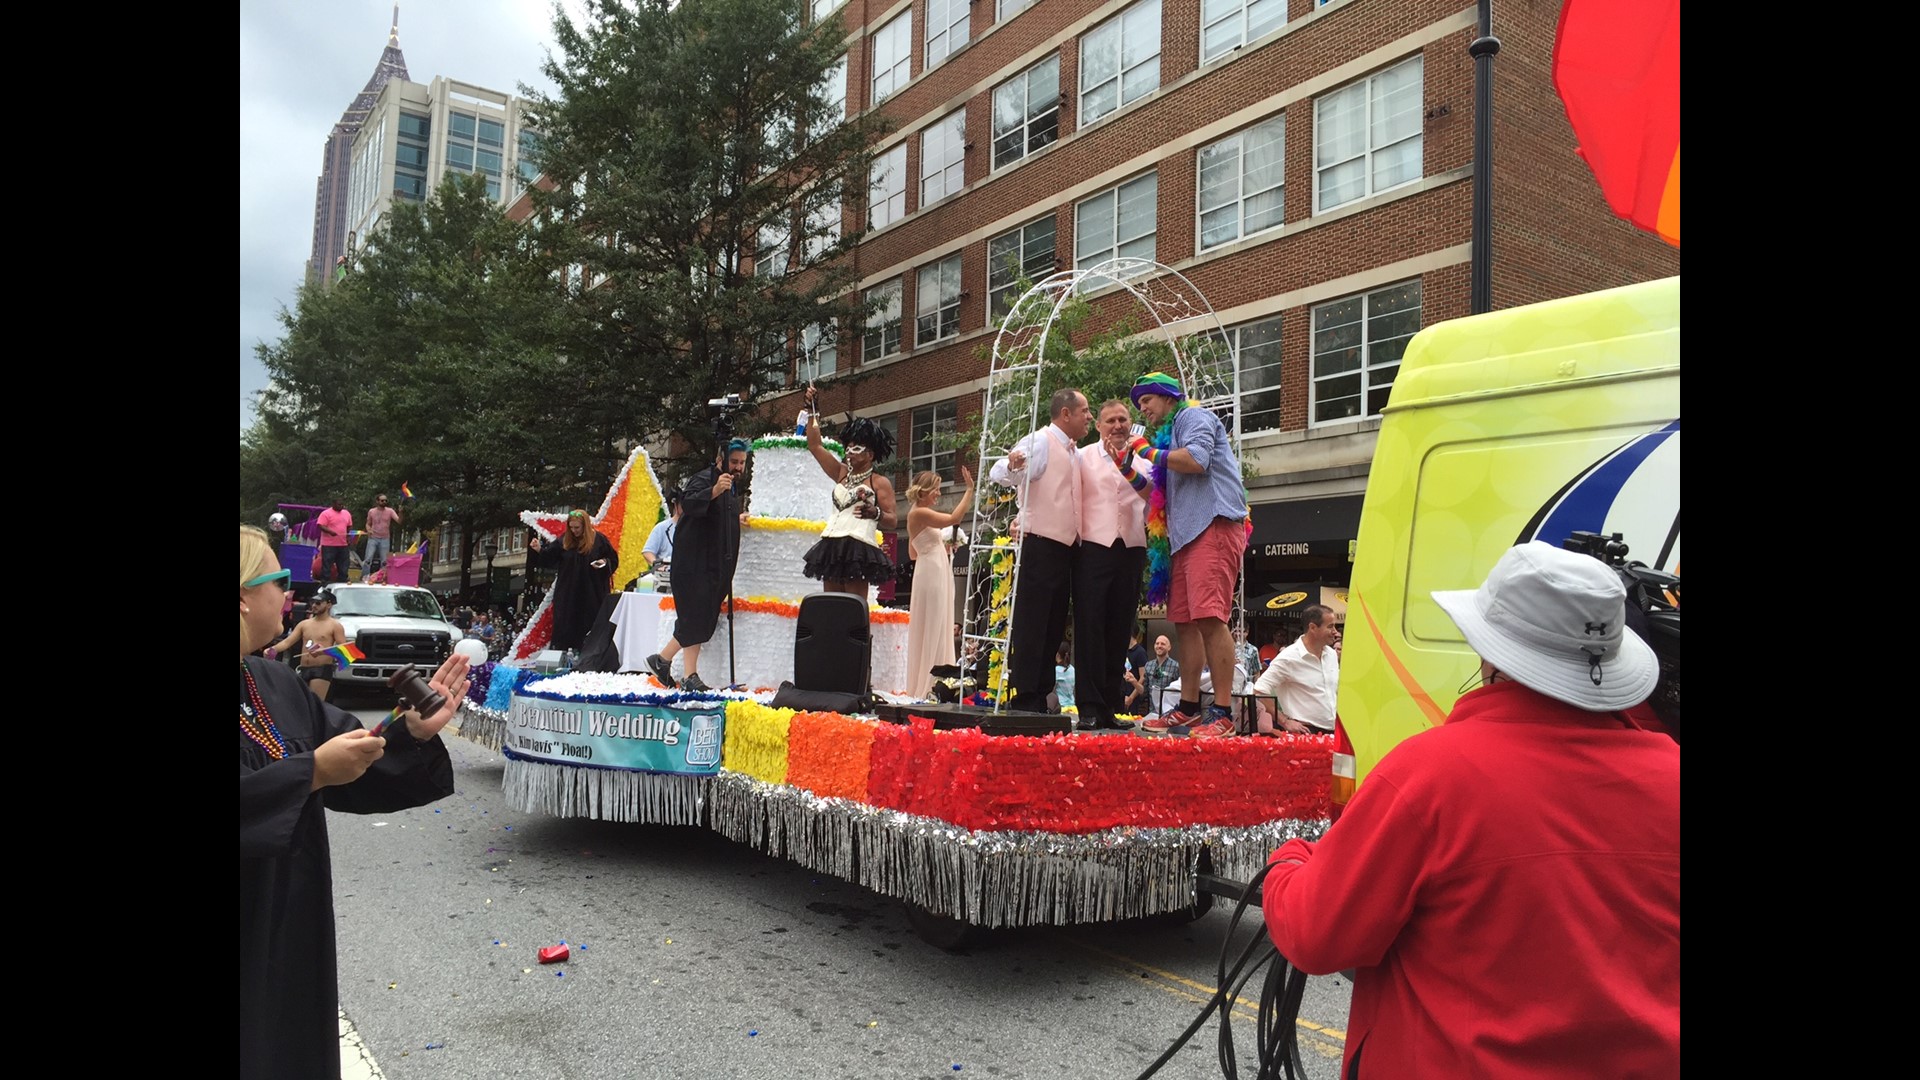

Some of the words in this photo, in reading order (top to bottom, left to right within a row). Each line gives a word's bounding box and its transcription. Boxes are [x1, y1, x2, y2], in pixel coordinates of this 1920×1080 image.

[1264, 543, 1309, 556] CATERING
[519, 702, 583, 735] Beautiful
[588, 710, 681, 746] Wedding
[561, 742, 593, 760] Float!)
